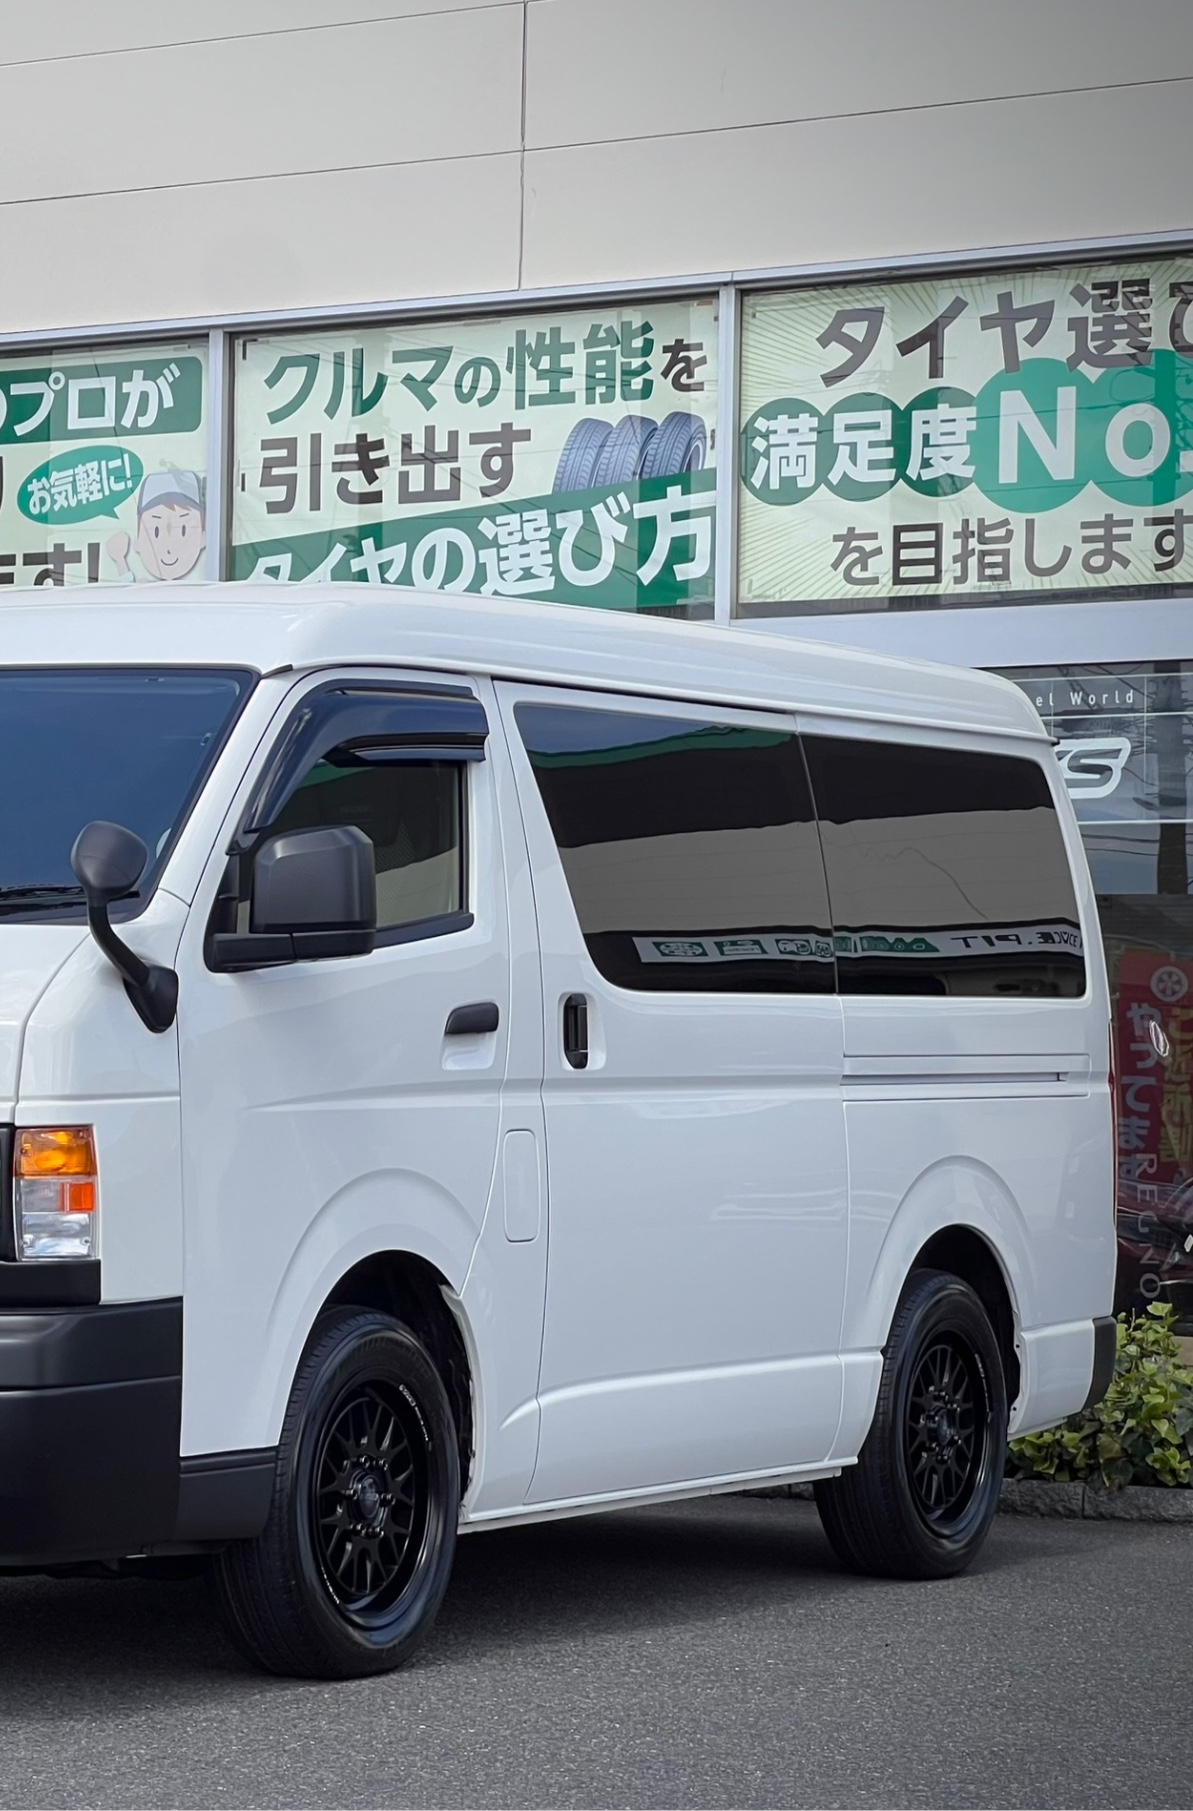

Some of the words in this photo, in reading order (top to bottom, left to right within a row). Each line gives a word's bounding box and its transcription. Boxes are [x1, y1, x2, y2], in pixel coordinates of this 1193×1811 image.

[263, 320, 707, 425] クルマの性能を
[26, 452, 134, 516] お気軽に!
[259, 422, 531, 514] 引き出す
[829, 508, 1193, 587] を目指します
[1069, 689, 1134, 706] World
